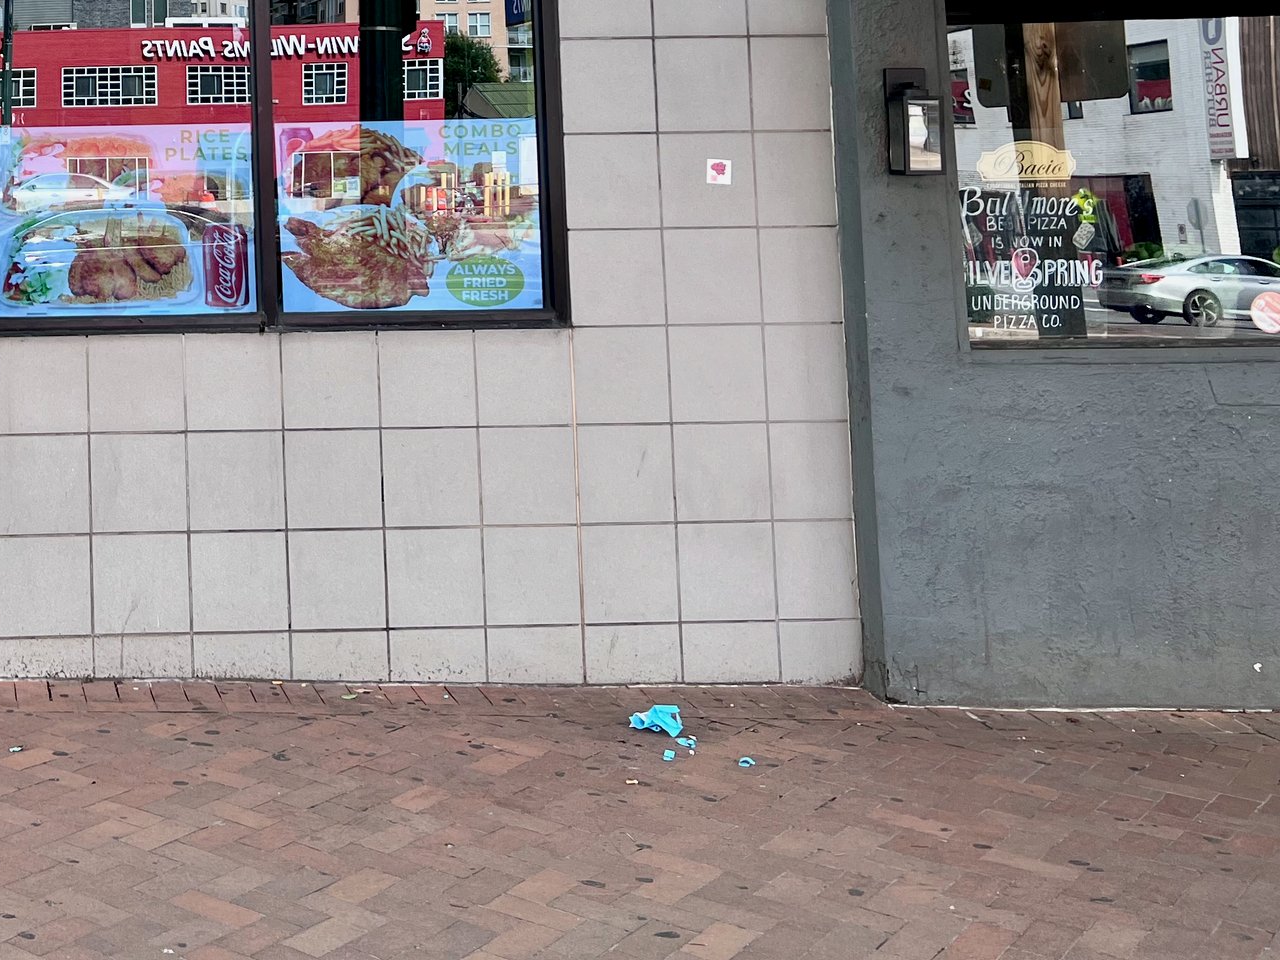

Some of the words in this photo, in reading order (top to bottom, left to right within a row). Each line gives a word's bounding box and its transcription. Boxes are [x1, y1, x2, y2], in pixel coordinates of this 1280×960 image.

[180, 129, 230, 145] RICE
[439, 123, 521, 139] COMBO
[164, 145, 248, 162] PLATES
[443, 140, 518, 156] MEALS
[1027, 217, 1068, 230] PIZZA
[991, 237, 1004, 249] IS
[1011, 236, 1044, 248] NOW
[1048, 236, 1062, 247] IN
[454, 263, 516, 276] ALWAYS
[463, 277, 507, 289] FRIED
[461, 290, 509, 302] FRESH
[971, 294, 1080, 311] UNDERGROUND
[994, 315, 1038, 329] PIZZA
[1042, 314, 1062, 328] CO.
